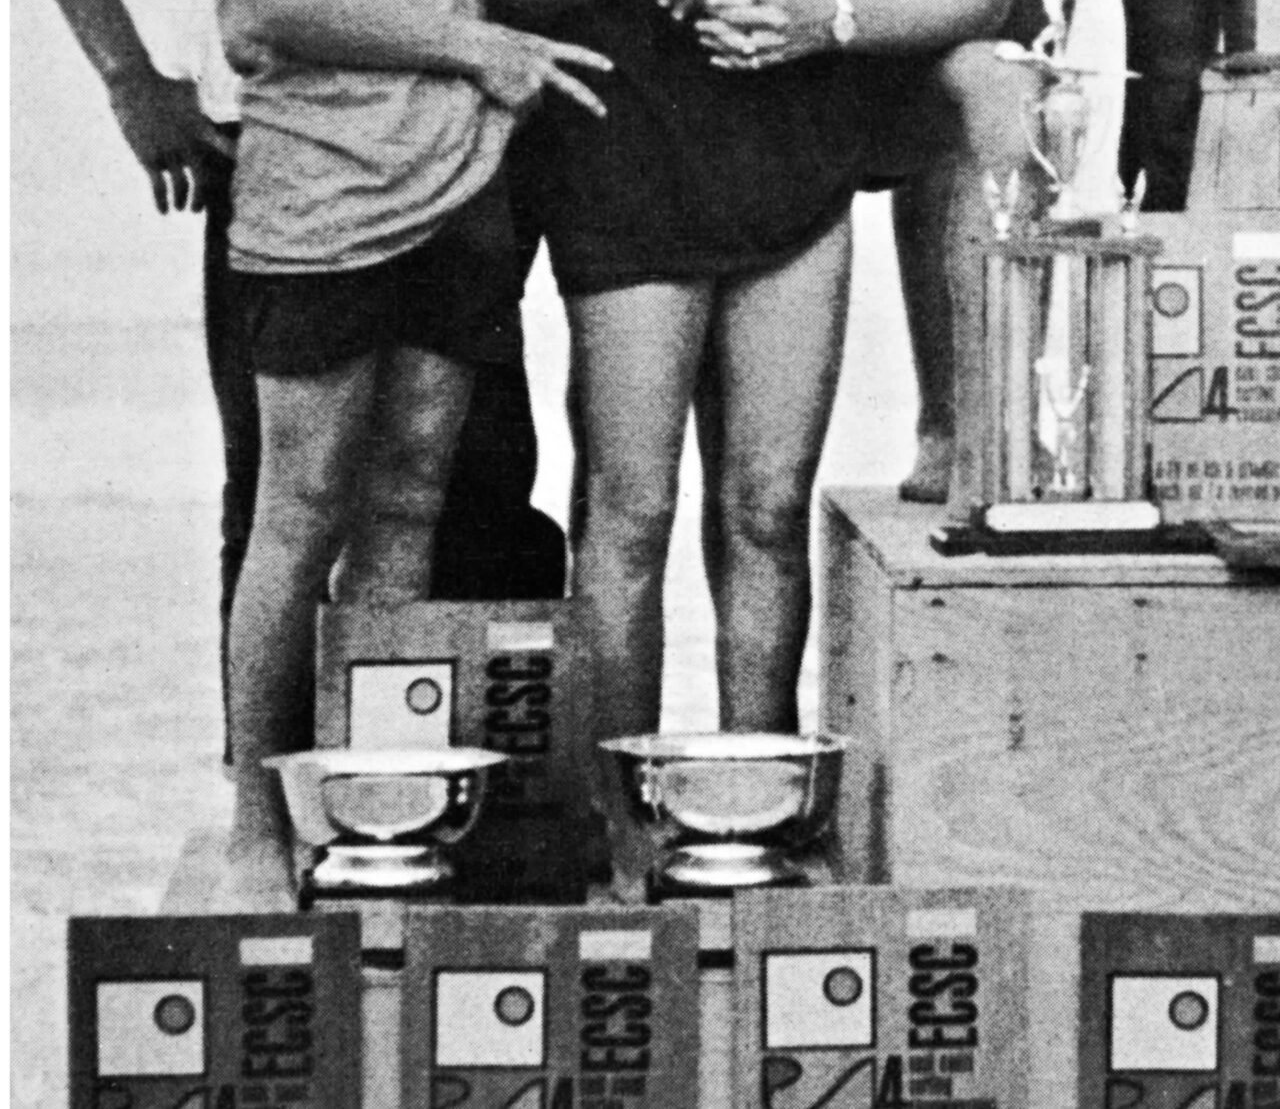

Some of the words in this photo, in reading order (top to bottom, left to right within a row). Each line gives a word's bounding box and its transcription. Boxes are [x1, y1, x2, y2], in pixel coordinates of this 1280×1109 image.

[241, 970, 315, 1078] ECSC
[580, 965, 652, 1073] ECSC
[908, 942, 978, 1049] ECSC
